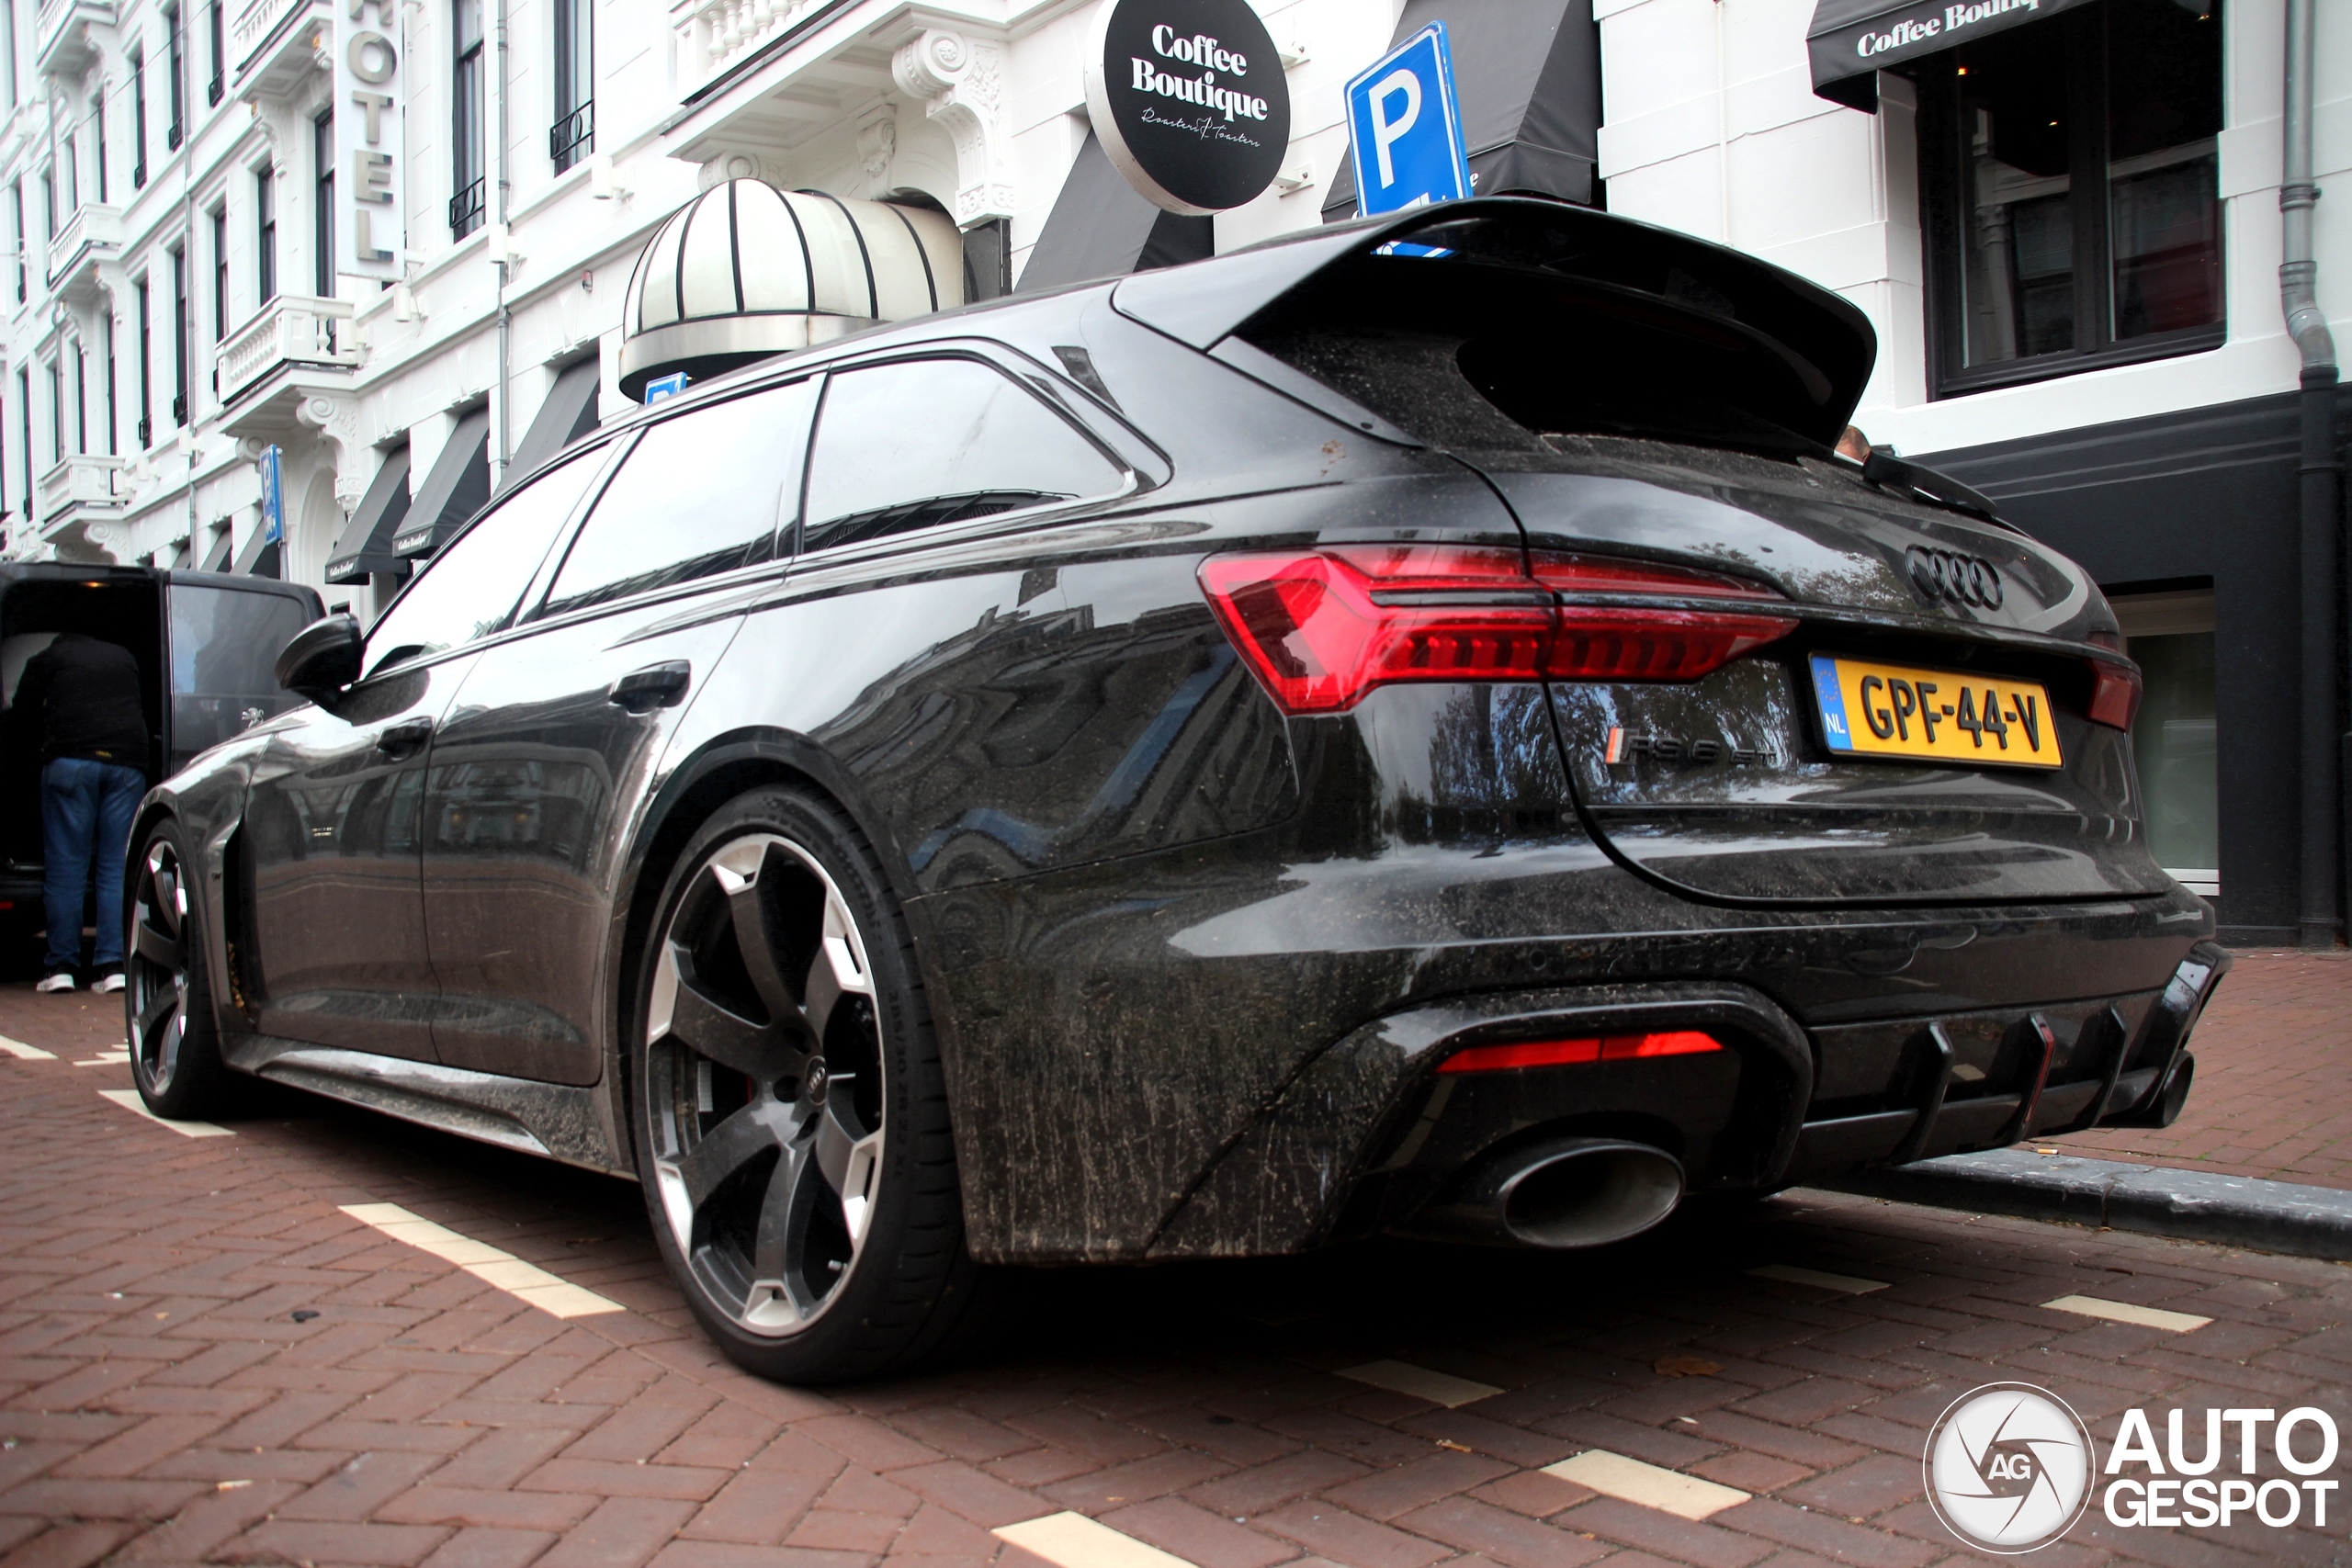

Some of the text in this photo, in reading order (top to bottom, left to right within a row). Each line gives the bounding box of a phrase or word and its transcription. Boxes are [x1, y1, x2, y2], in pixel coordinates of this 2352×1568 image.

[1151, 24, 1247, 77] Coffee
[1857, 18, 1941, 58] Coffee
[1131, 57, 1268, 122] Boutique
[1141, 107, 1199, 132] Roasters
[1212, 125, 1261, 147] Toasters
[1368, 68, 1422, 190] P
[262, 458, 271, 505] P
[1825, 712, 1846, 734] NL
[1860, 675, 2041, 752] GPF-44-V
[1730, 749, 1777, 764] GT
